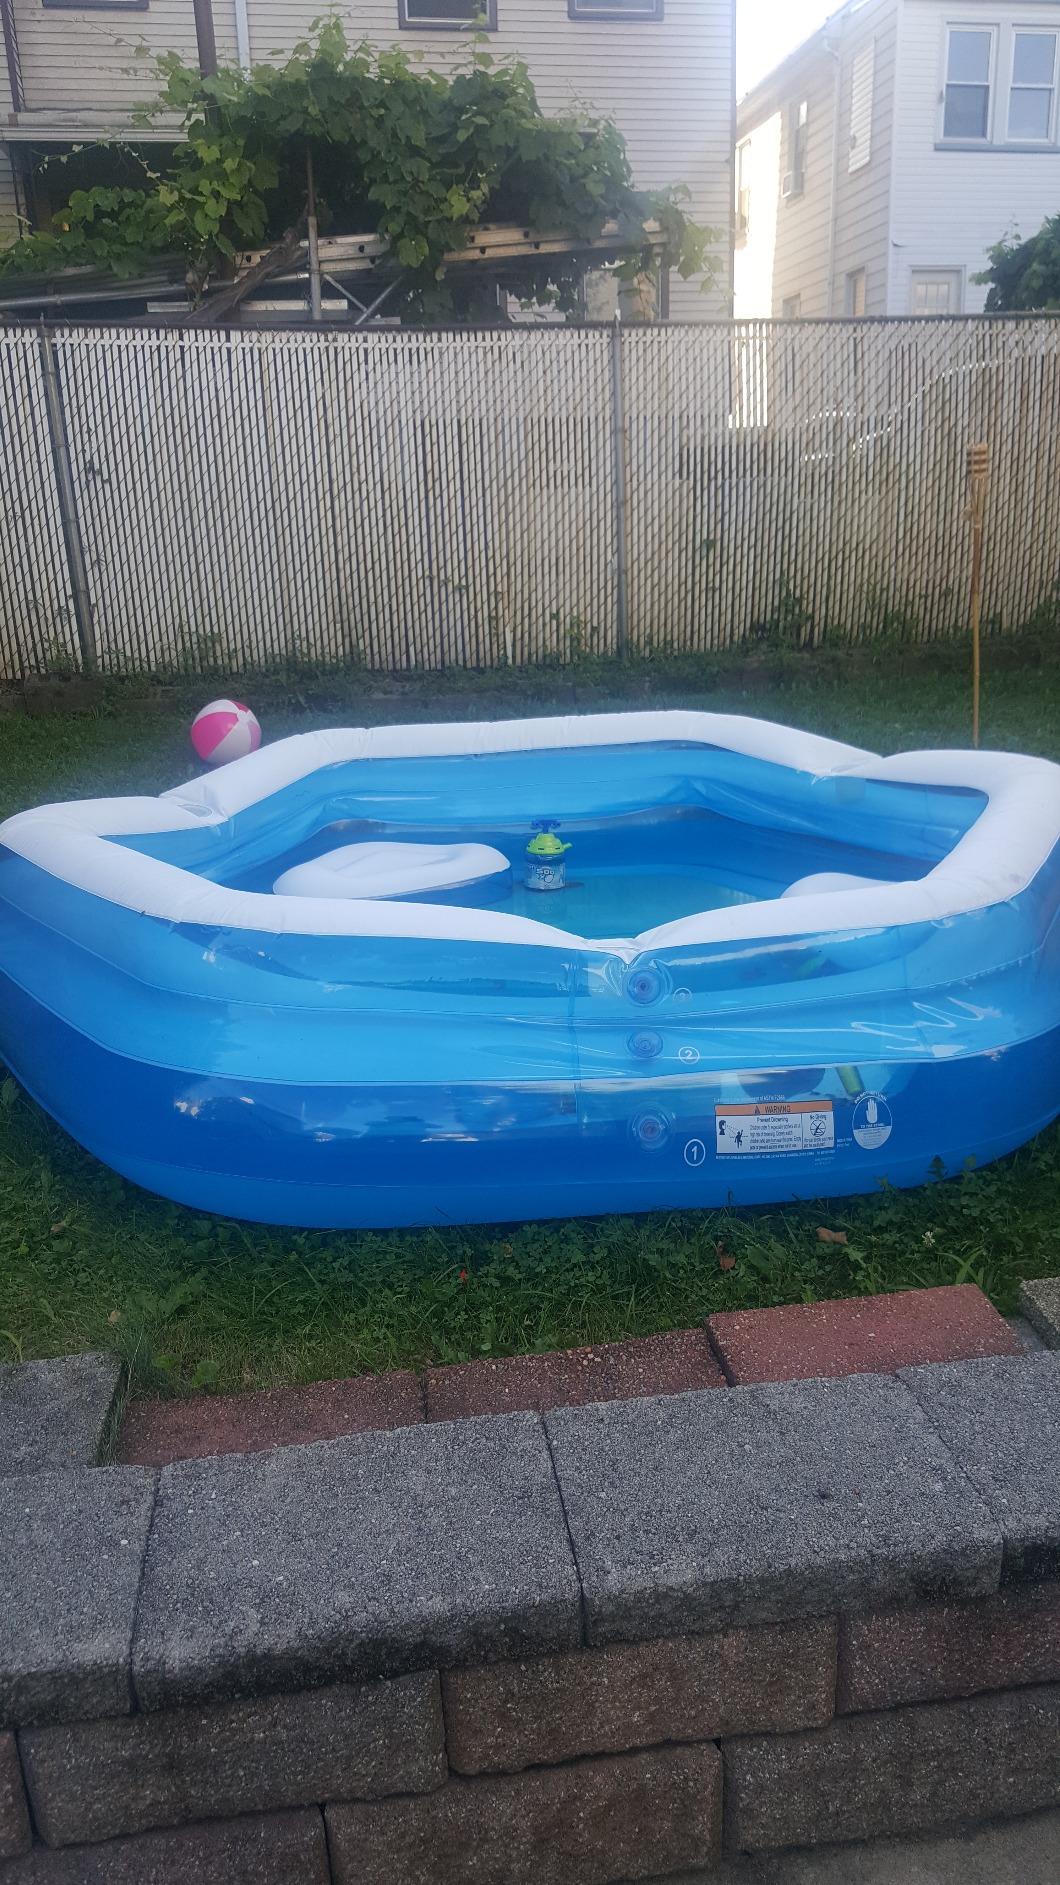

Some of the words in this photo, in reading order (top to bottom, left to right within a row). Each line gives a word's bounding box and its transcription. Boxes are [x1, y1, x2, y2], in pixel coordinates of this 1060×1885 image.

[685, 1050, 693, 1060] 2
[765, 1105, 791, 1113] WARNING
[691, 1145, 698, 1161] 1
